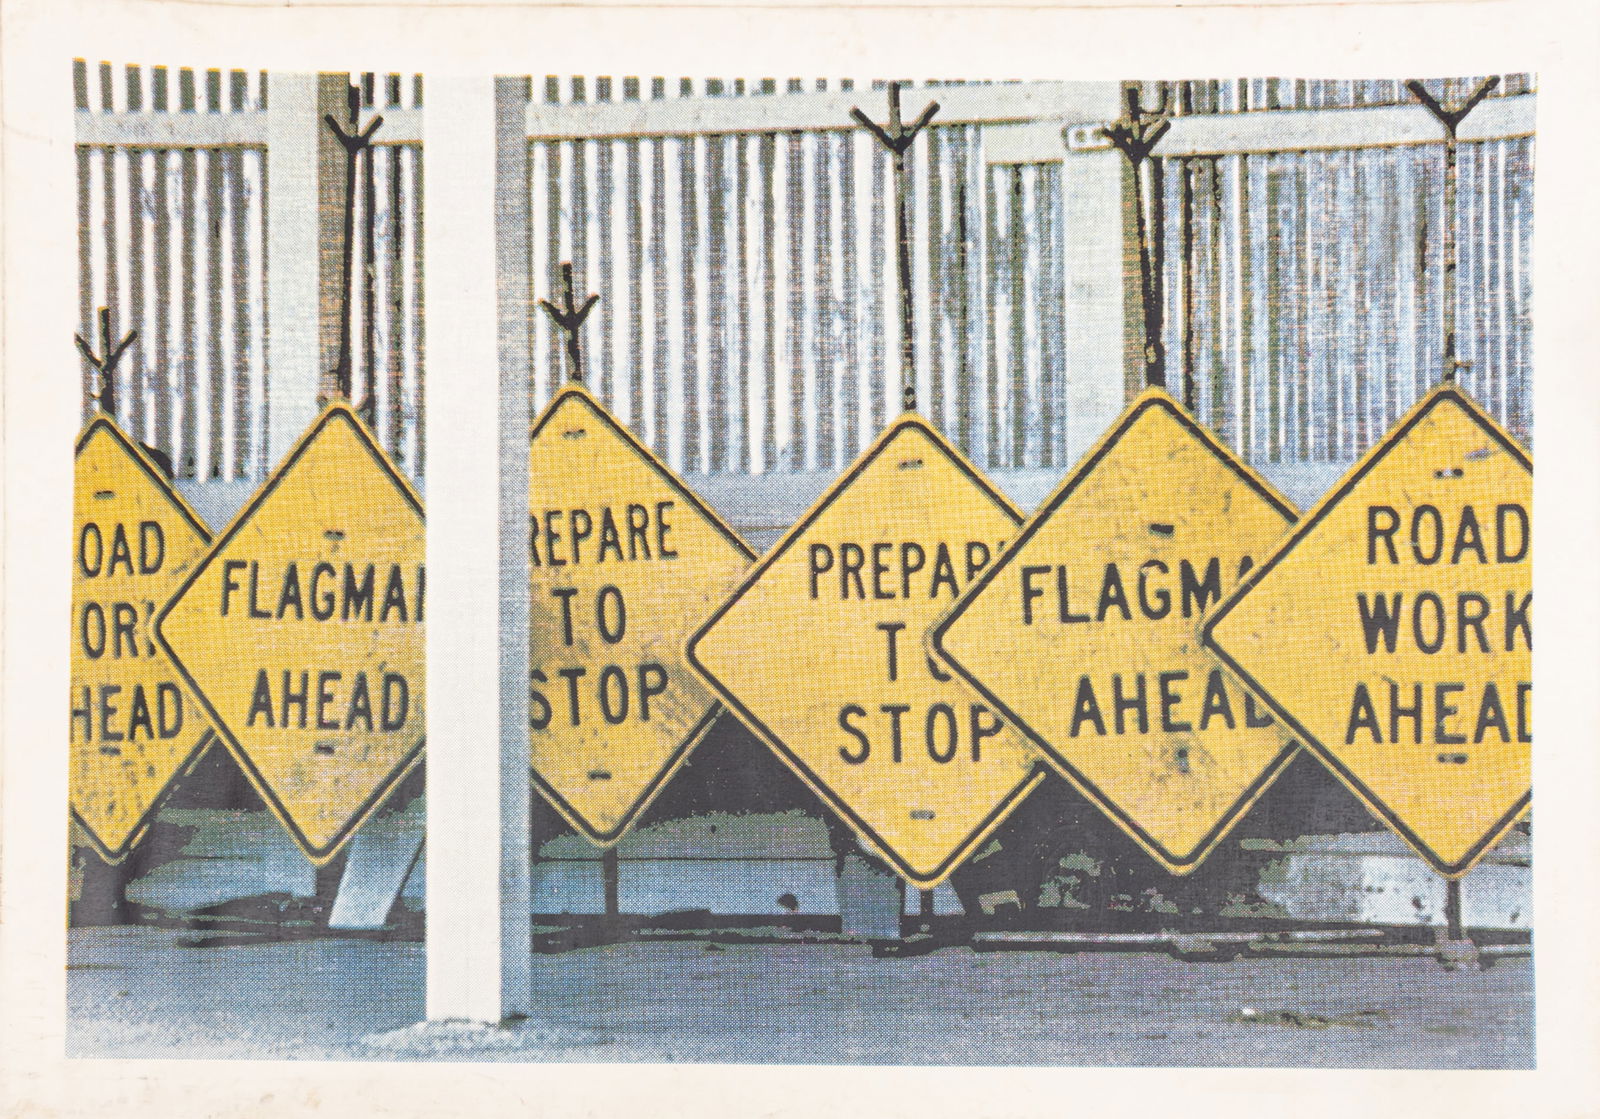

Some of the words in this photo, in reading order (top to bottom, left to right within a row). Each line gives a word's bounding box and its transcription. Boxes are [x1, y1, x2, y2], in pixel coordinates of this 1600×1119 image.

[78, 521, 165, 578] OAD
[1367, 503, 1530, 565] ROAD
[809, 541, 1006, 600] PREPAR
[552, 585, 626, 646] TO
[1356, 590, 1532, 655] WORK
[876, 622, 952, 682] T
[246, 668, 409, 732] AHEAD
[530, 663, 669, 729] STOP
[838, 703, 1003, 764] STOP
